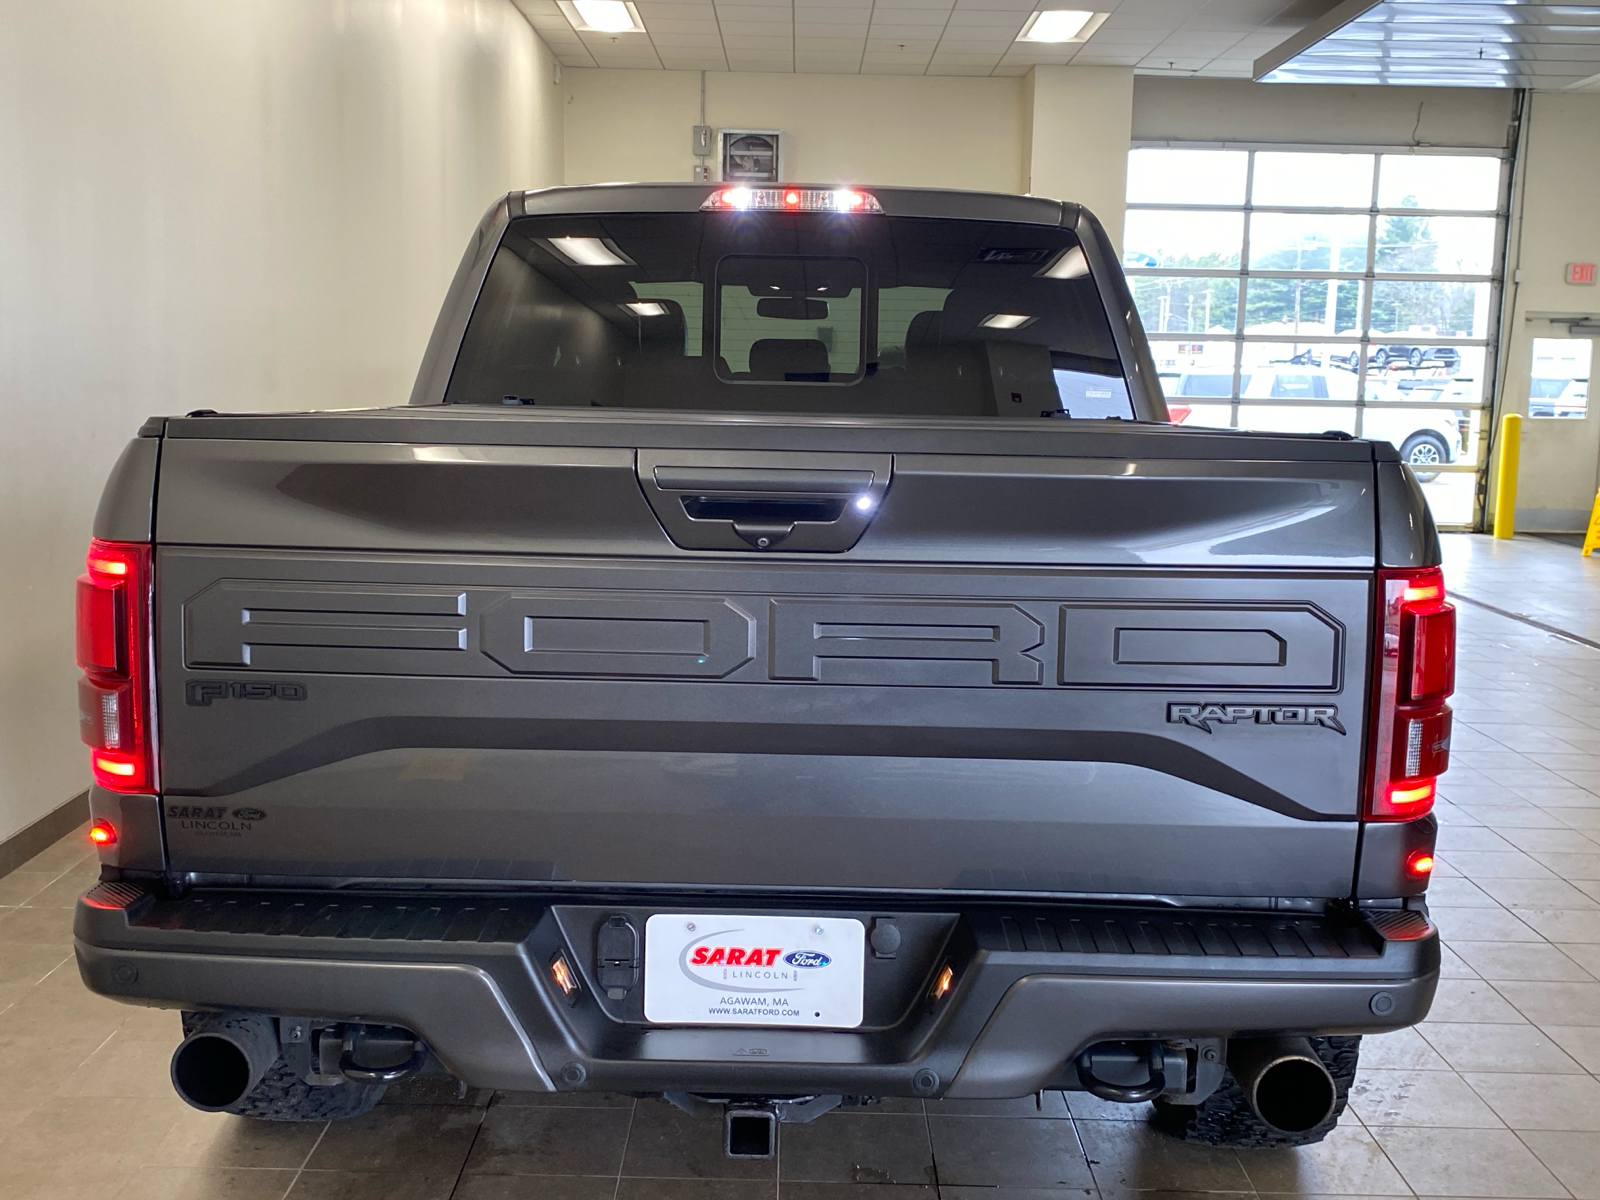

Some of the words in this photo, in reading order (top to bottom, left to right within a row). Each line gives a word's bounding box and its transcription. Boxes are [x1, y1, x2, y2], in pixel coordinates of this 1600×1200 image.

[1571, 263, 1595, 282] EXIT
[183, 578, 1346, 693] FORD
[1166, 702, 1347, 736] RAPTOR
[167, 805, 228, 820] SARAT
[236, 809, 263, 820] Ford
[181, 820, 252, 831] LINCOLN
[689, 946, 784, 967] SARAT
[790, 951, 824, 967] Ford
[732, 971, 788, 980] LINCOLN
[719, 996, 770, 1007] AGAWAM,
[773, 998, 789, 1007] MA
[708, 1007, 800, 1017] WWW.SARATFORD.COM
